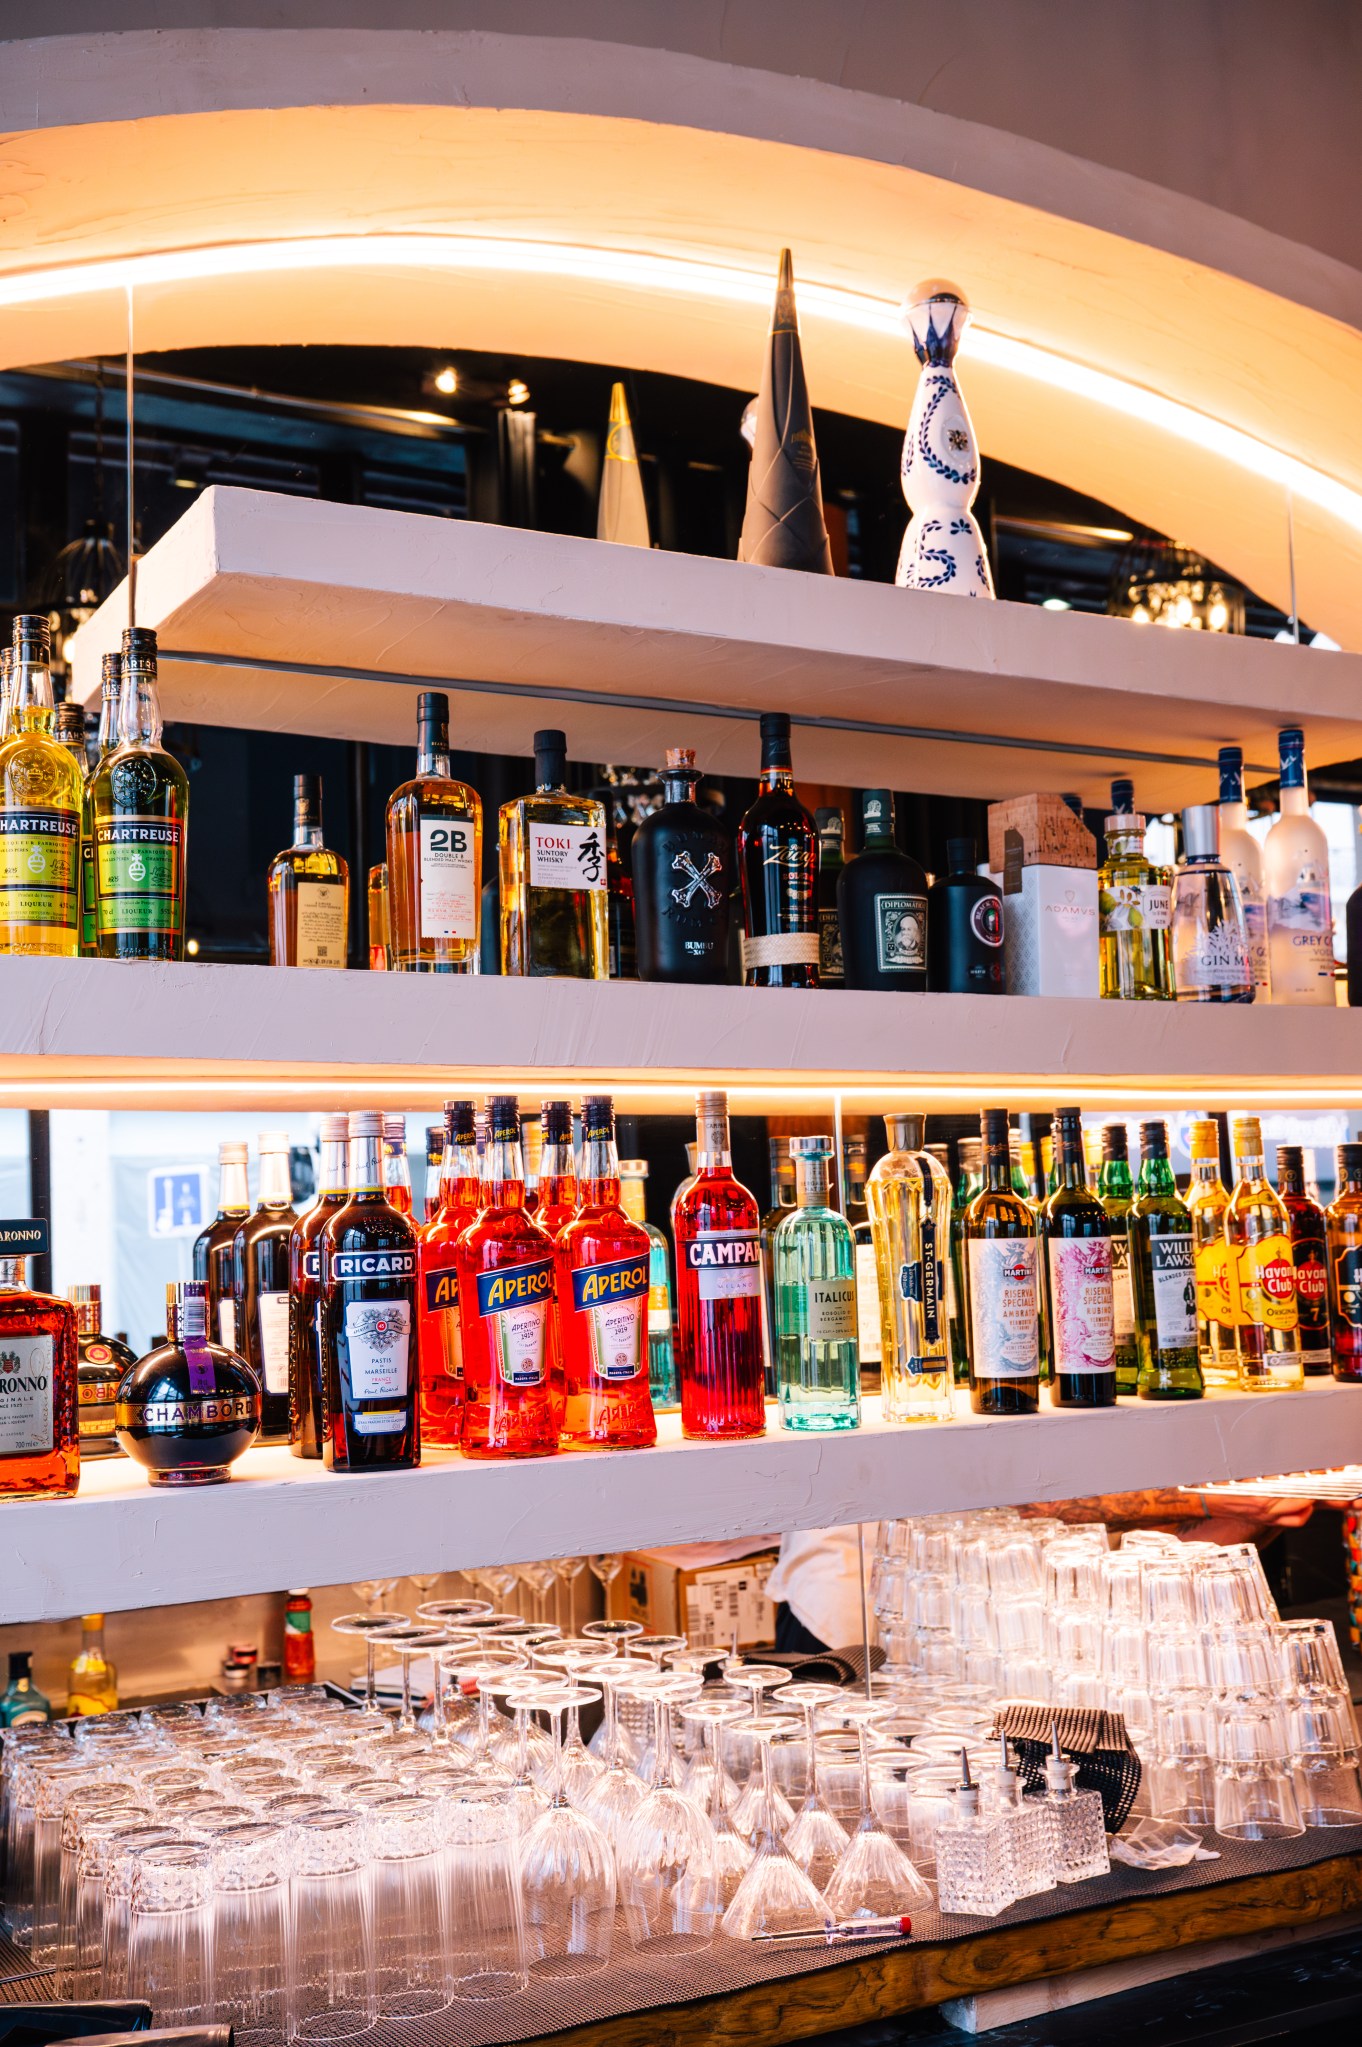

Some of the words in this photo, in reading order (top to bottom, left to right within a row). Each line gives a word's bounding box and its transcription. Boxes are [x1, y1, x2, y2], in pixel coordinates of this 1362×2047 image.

[97, 828, 179, 842] CHARTREUSE
[430, 829, 467, 853] 2B
[535, 836, 571, 850] TOKI
[536, 849, 568, 857] SUNTORY
[537, 856, 564, 864] WHISKY
[1148, 899, 1169, 911] JUNE
[1292, 935, 1321, 947] GREY
[1201, 954, 1231, 967] GIN
[454, 1130, 475, 1142] APEROL
[494, 1127, 517, 1139] APEROL
[587, 1127, 610, 1139] APEROL
[340, 1256, 413, 1274] RICARD
[924, 1242, 936, 1319] ST-GERMAIN
[1158, 1272, 1182, 1283] BLENDED
[487, 1269, 552, 1307] APEROL
[582, 1269, 648, 1303] APEROL
[1085, 1286, 1111, 1296] RISERVA
[1267, 1278, 1293, 1293] Club
[1299, 1280, 1325, 1293] Club
[1004, 1289, 1034, 1298] RISERVA
[1002, 1298, 1035, 1308] SPECIALE
[1083, 1295, 1112, 1305] SPECIALE
[1003, 1309, 1035, 1318] AMBRATO
[1086, 1306, 1111, 1315] RUBINO
[1310, 1307, 1319, 1321] 7
[511, 1318, 541, 1332] APERITIVO
[605, 1313, 635, 1327] APERITIVO
[521, 1331, 534, 1340] 1919
[614, 1326, 628, 1335] 1919
[364, 1367, 398, 1375] MARSEILLE
[143, 1401, 254, 1423] CHAMBORD
